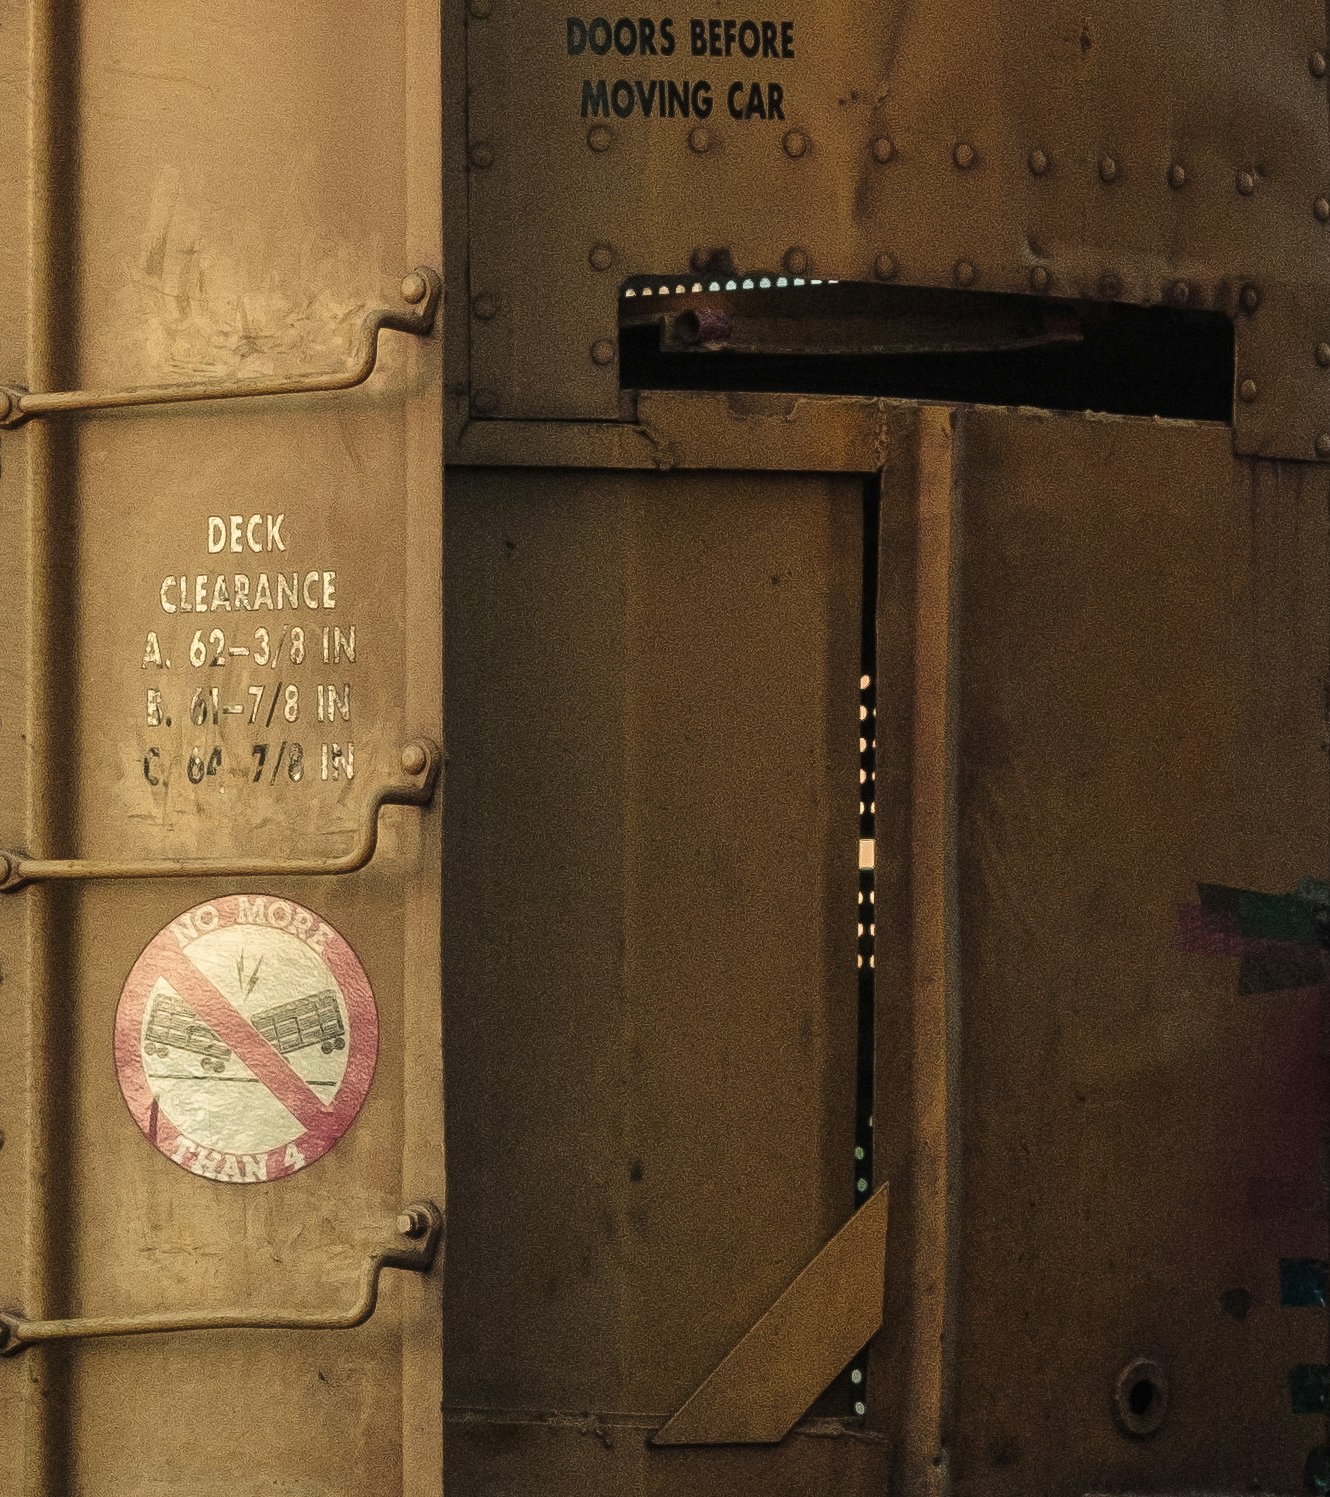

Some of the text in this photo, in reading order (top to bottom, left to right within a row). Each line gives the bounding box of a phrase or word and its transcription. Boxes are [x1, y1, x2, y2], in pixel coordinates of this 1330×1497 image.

[567, 18, 794, 58] DOORS BEFORE
[580, 80, 785, 120] MOVING CAR
[207, 514, 286, 553] DECK
[160, 571, 336, 613] CLEARANCE
[190, 625, 305, 669] 62-3/8
[323, 625, 356, 664] IN
[318, 683, 350, 722] IN
[321, 742, 354, 781] IN
[170, 897, 334, 953] NO MORE
[171, 1135, 269, 1181] THAN
